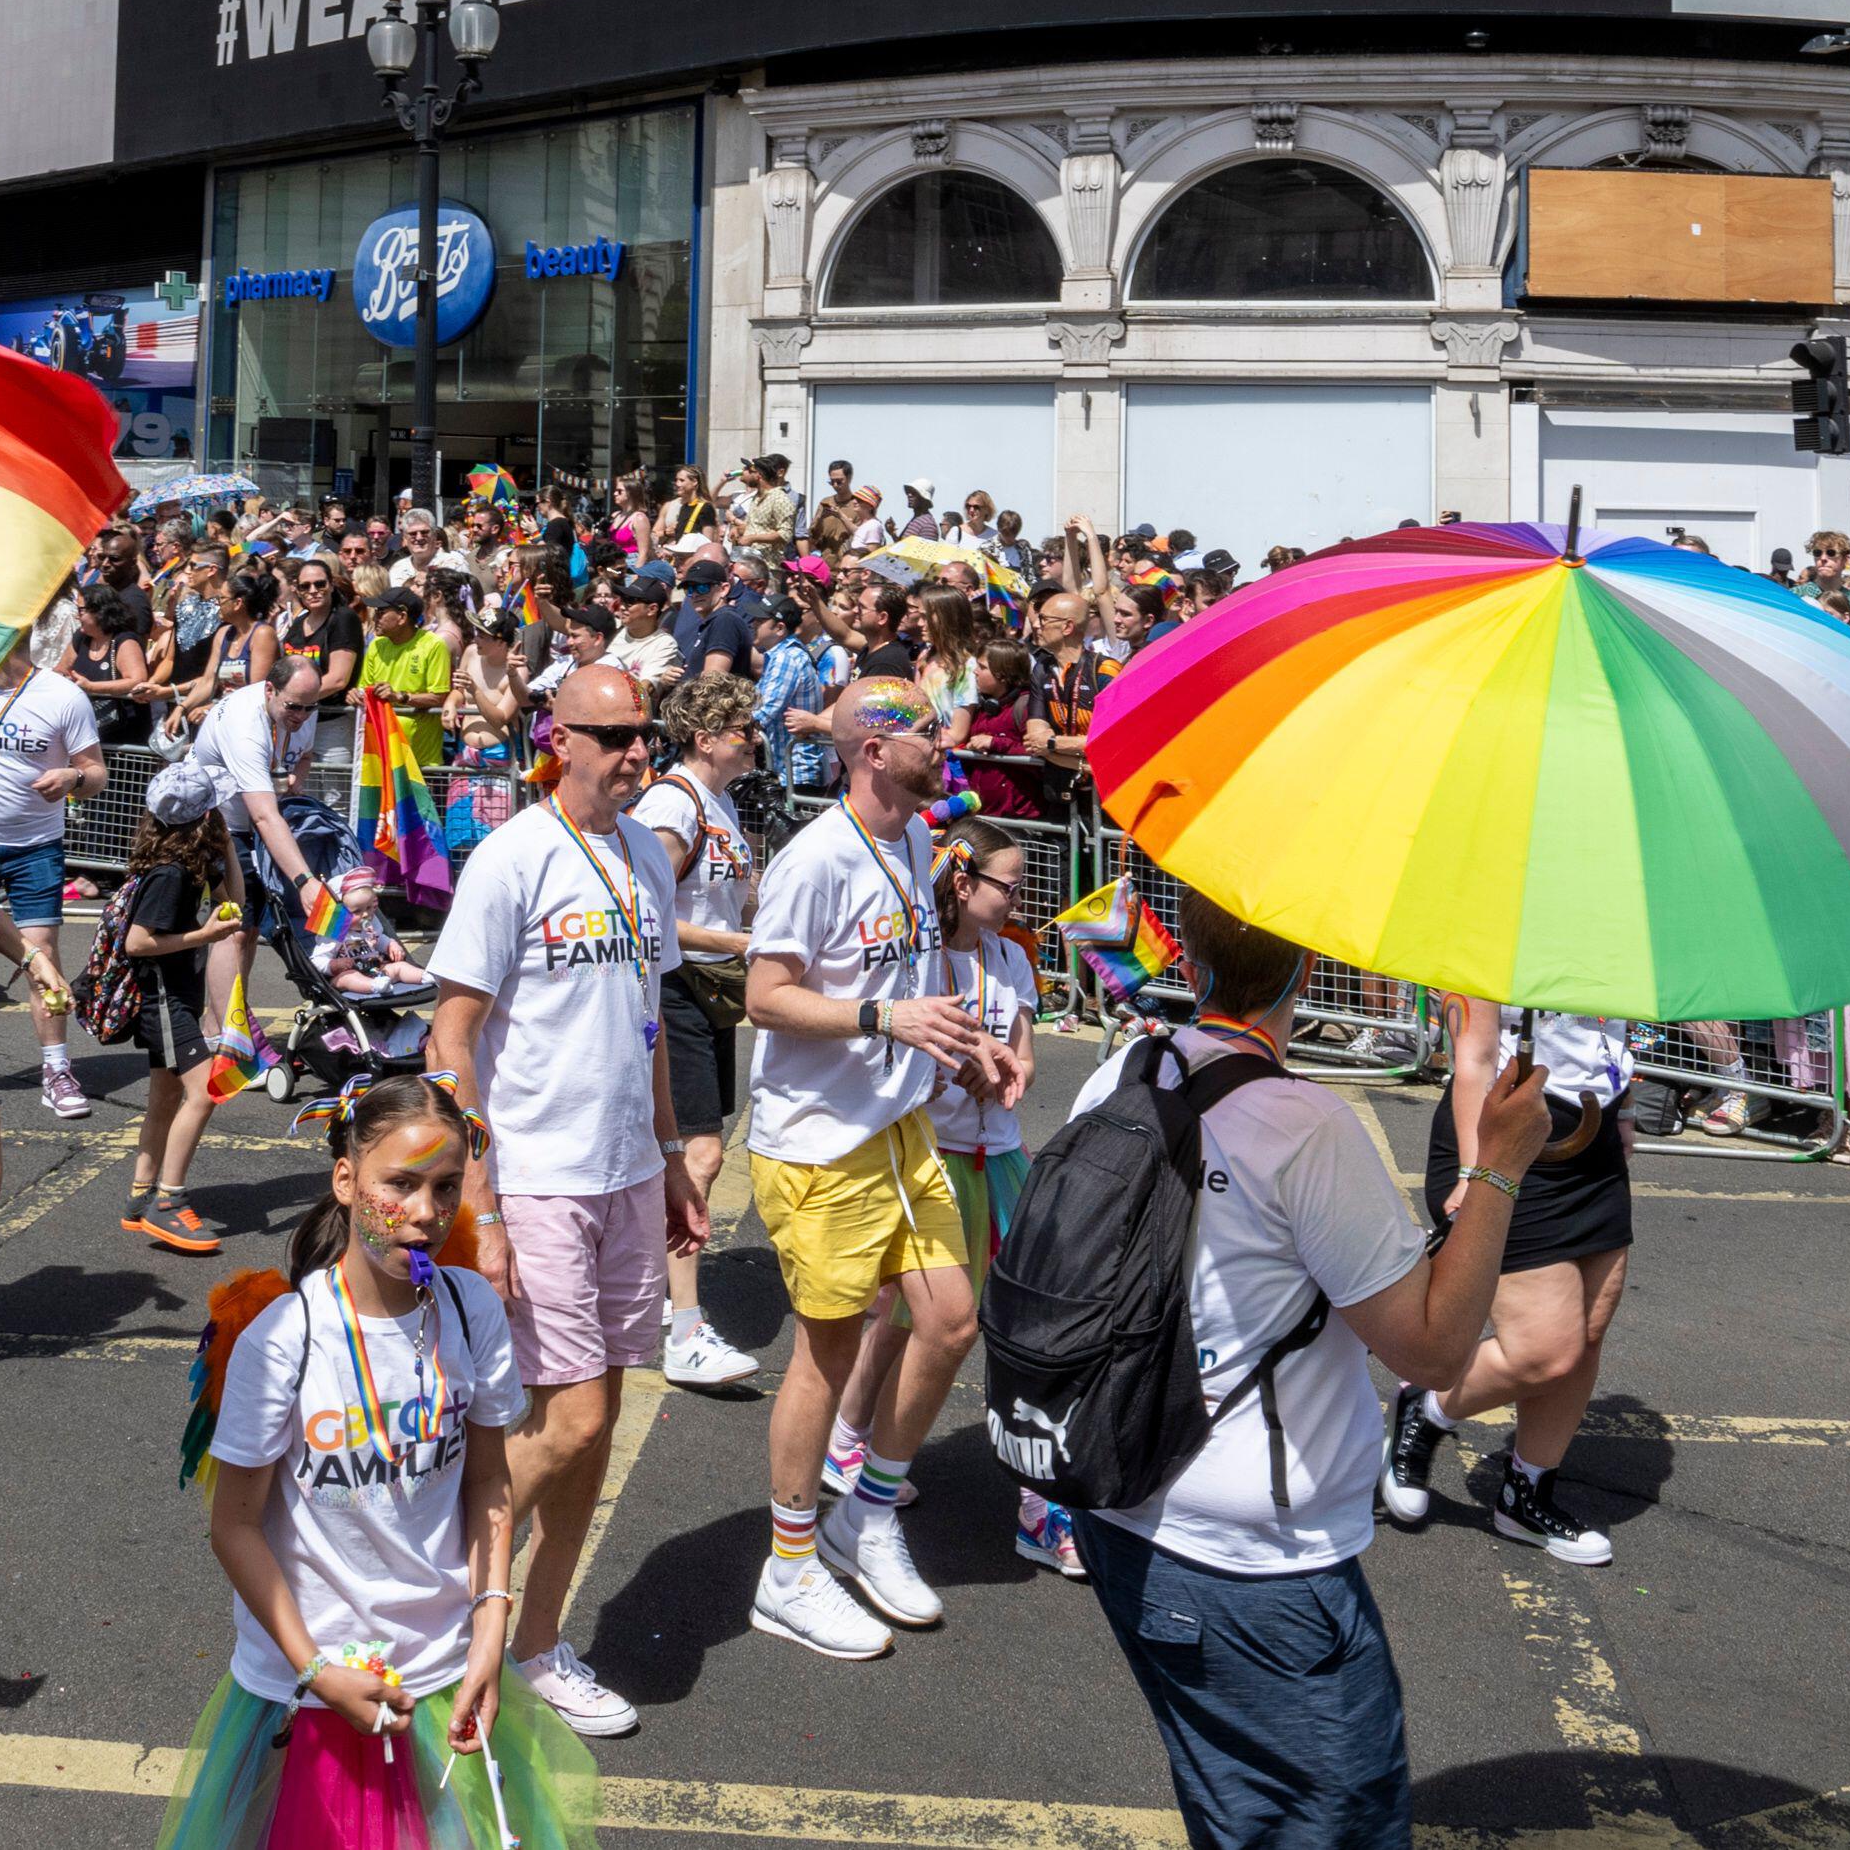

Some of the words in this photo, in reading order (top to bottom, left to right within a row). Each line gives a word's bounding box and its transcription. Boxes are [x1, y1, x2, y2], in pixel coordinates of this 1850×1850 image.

[362, 220, 470, 322] Bots
[525, 235, 627, 282] beauty
[226, 266, 336, 309] pharmacy
[542, 908, 657, 943] LGBT+
[858, 902, 935, 946] LGBQ+
[546, 936, 662, 971] FAMILIE
[987, 1407, 1057, 1481] PUMA
